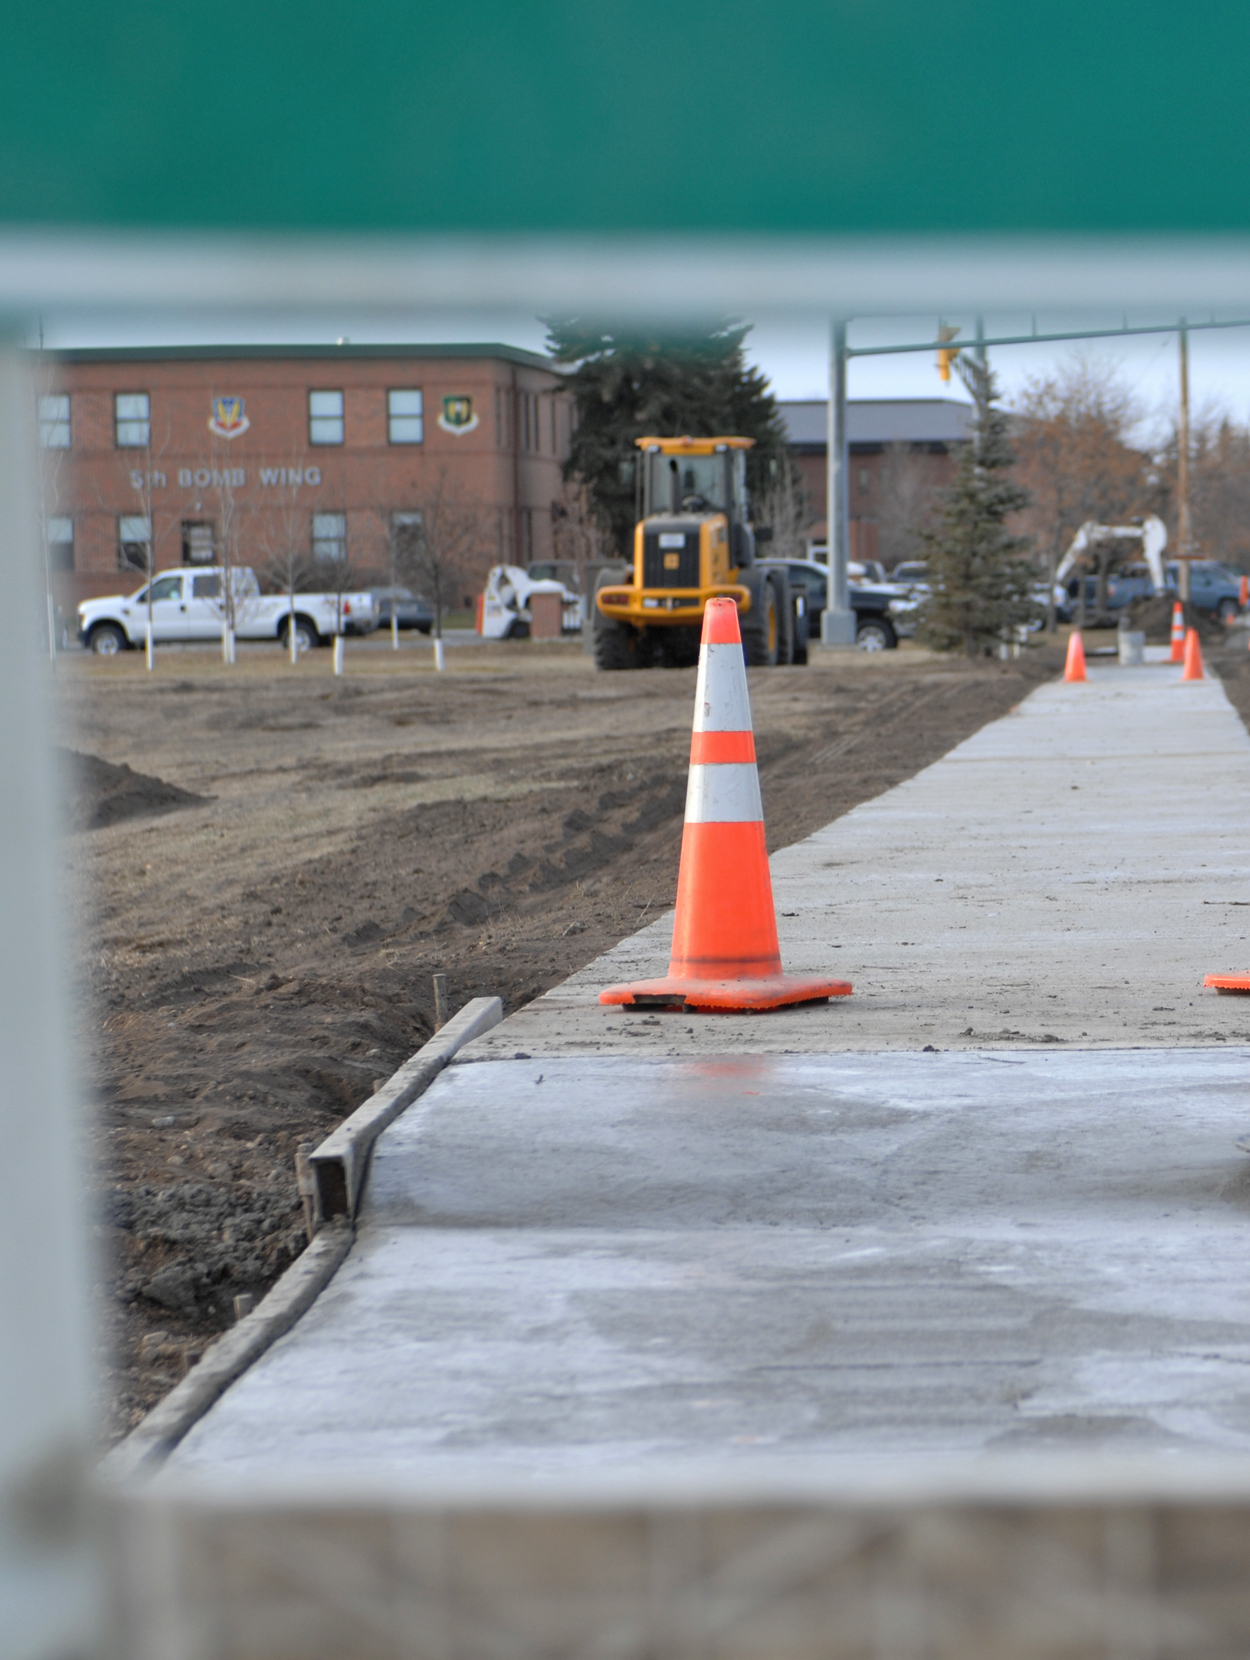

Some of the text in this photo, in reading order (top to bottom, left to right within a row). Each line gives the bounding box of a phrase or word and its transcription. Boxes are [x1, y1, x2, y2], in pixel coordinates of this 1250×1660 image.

[130, 467, 321, 489] 5h BOMB WING
